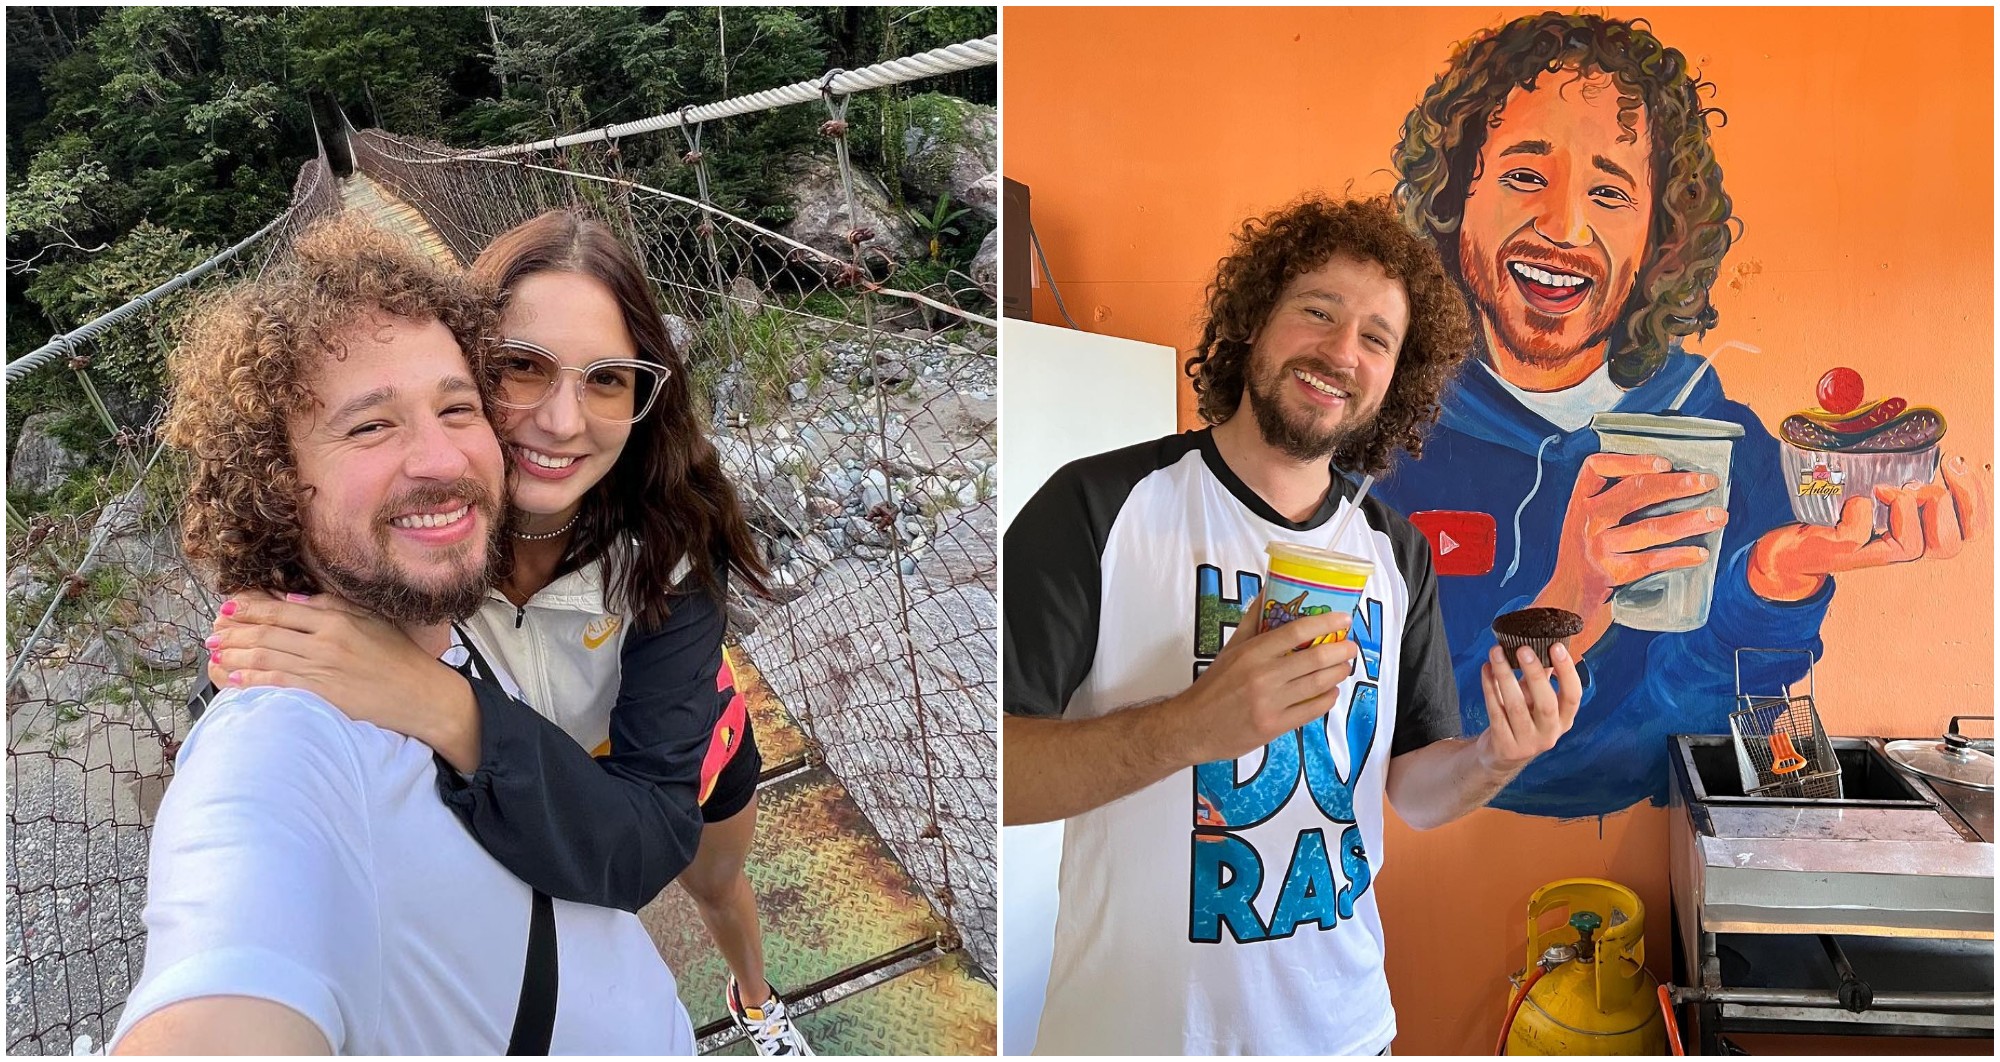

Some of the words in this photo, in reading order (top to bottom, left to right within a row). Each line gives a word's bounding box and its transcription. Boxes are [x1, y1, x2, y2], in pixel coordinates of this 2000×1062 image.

[1798, 482, 1840, 499] Antojo
[1194, 563, 1384, 681] HN
[1188, 824, 1372, 944] RAS
